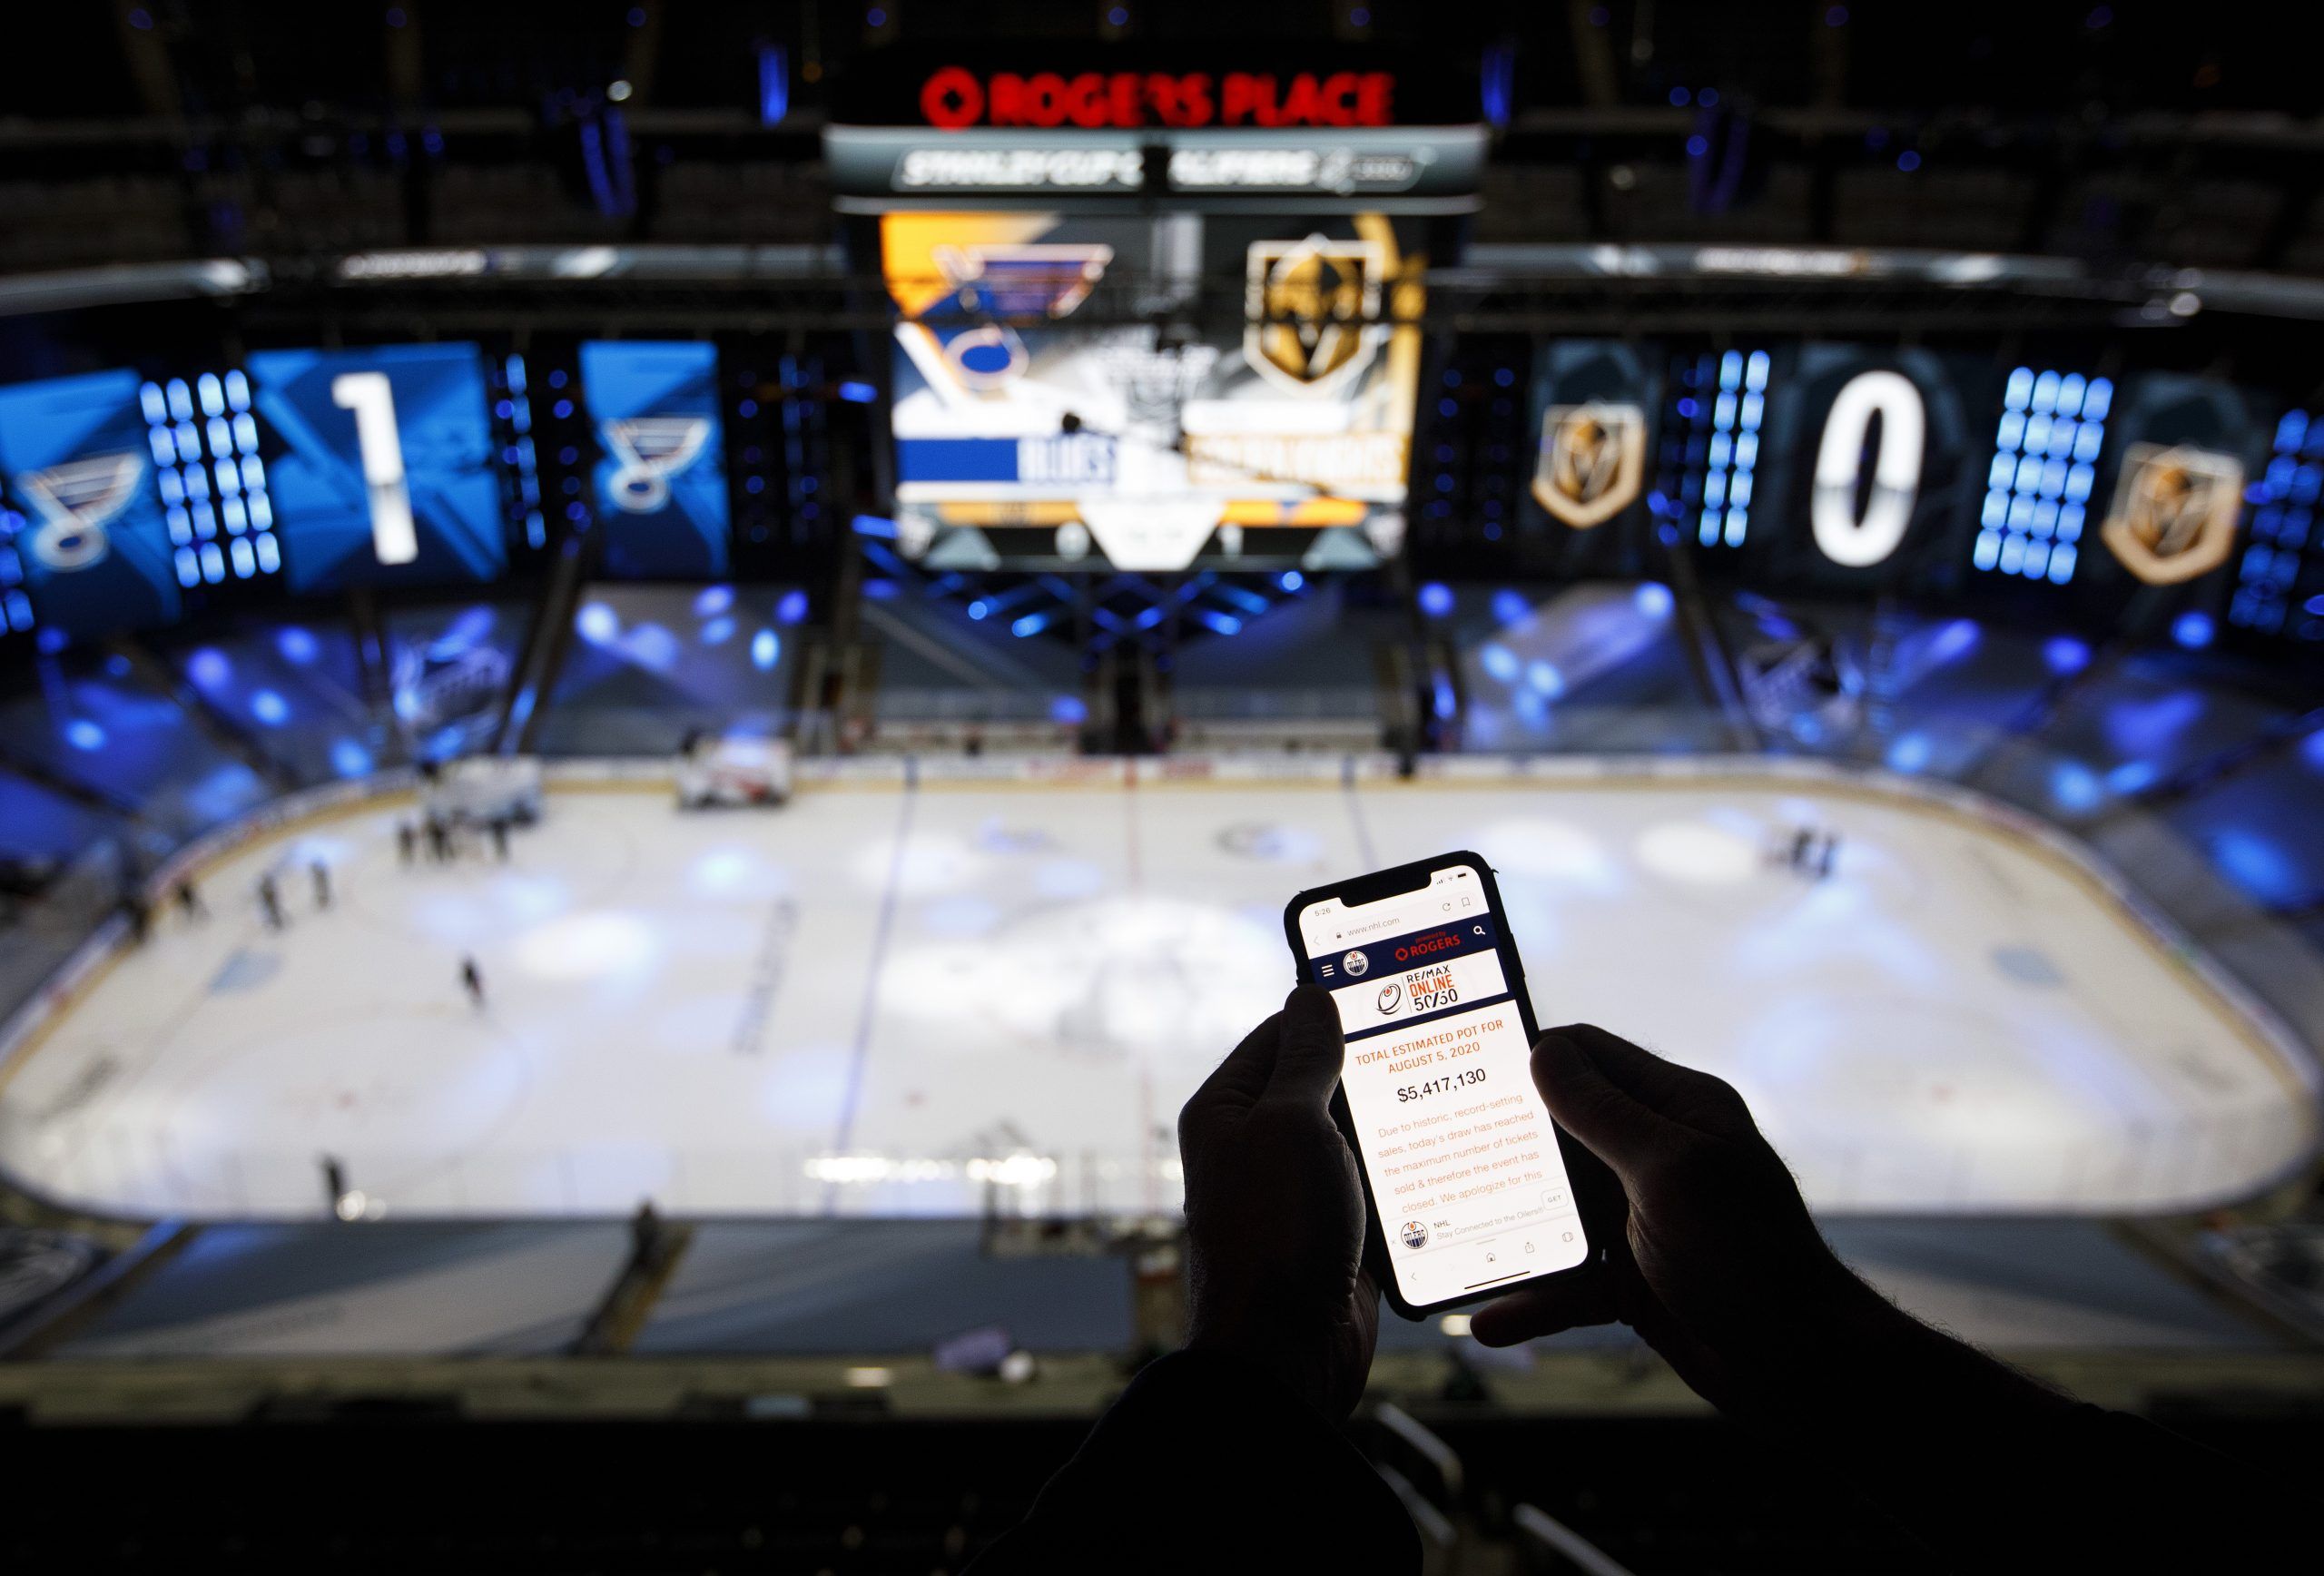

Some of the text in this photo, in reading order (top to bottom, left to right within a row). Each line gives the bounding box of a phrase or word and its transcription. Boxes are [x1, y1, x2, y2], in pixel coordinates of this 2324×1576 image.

[1221, 71, 1396, 128] PLACE
[331, 371, 419, 566] 1
[1809, 369, 1925, 567] 0
[1315, 908, 1331, 916] 5:26
[1347, 918, 1400, 935] www.nhl.com
[1410, 934, 1461, 957] ROGERS
[1406, 965, 1451, 983] RE/MAX
[1409, 974, 1455, 998] ONLINE
[1414, 989, 1458, 1011] 50/50
[1355, 1019, 1504, 1066] TOTAL ESTIMATED POT FOR
[1388, 1054, 1433, 1073] AUGUST
[1450, 1041, 1481, 1058] 2020
[1397, 1069, 1486, 1103] $5,417,130
[1378, 1094, 1523, 1138] Due to historic, record-setting
[1378, 1110, 1534, 1158] sales, today's draw has reached
[1384, 1130, 1539, 1177] the maximum number of tickets
[1393, 1150, 1540, 1196] sold & therefore the event has
[1402, 1169, 1543, 1214] closed. We apologize for this
[1547, 1195, 1562, 1204] GET
[1433, 1219, 1451, 1230] NHL
[1436, 1229, 1453, 1241] Stay
[1454, 1219, 1493, 1236] Connected
[1494, 1216, 1503, 1226] to
[1503, 1211, 1516, 1222] the
